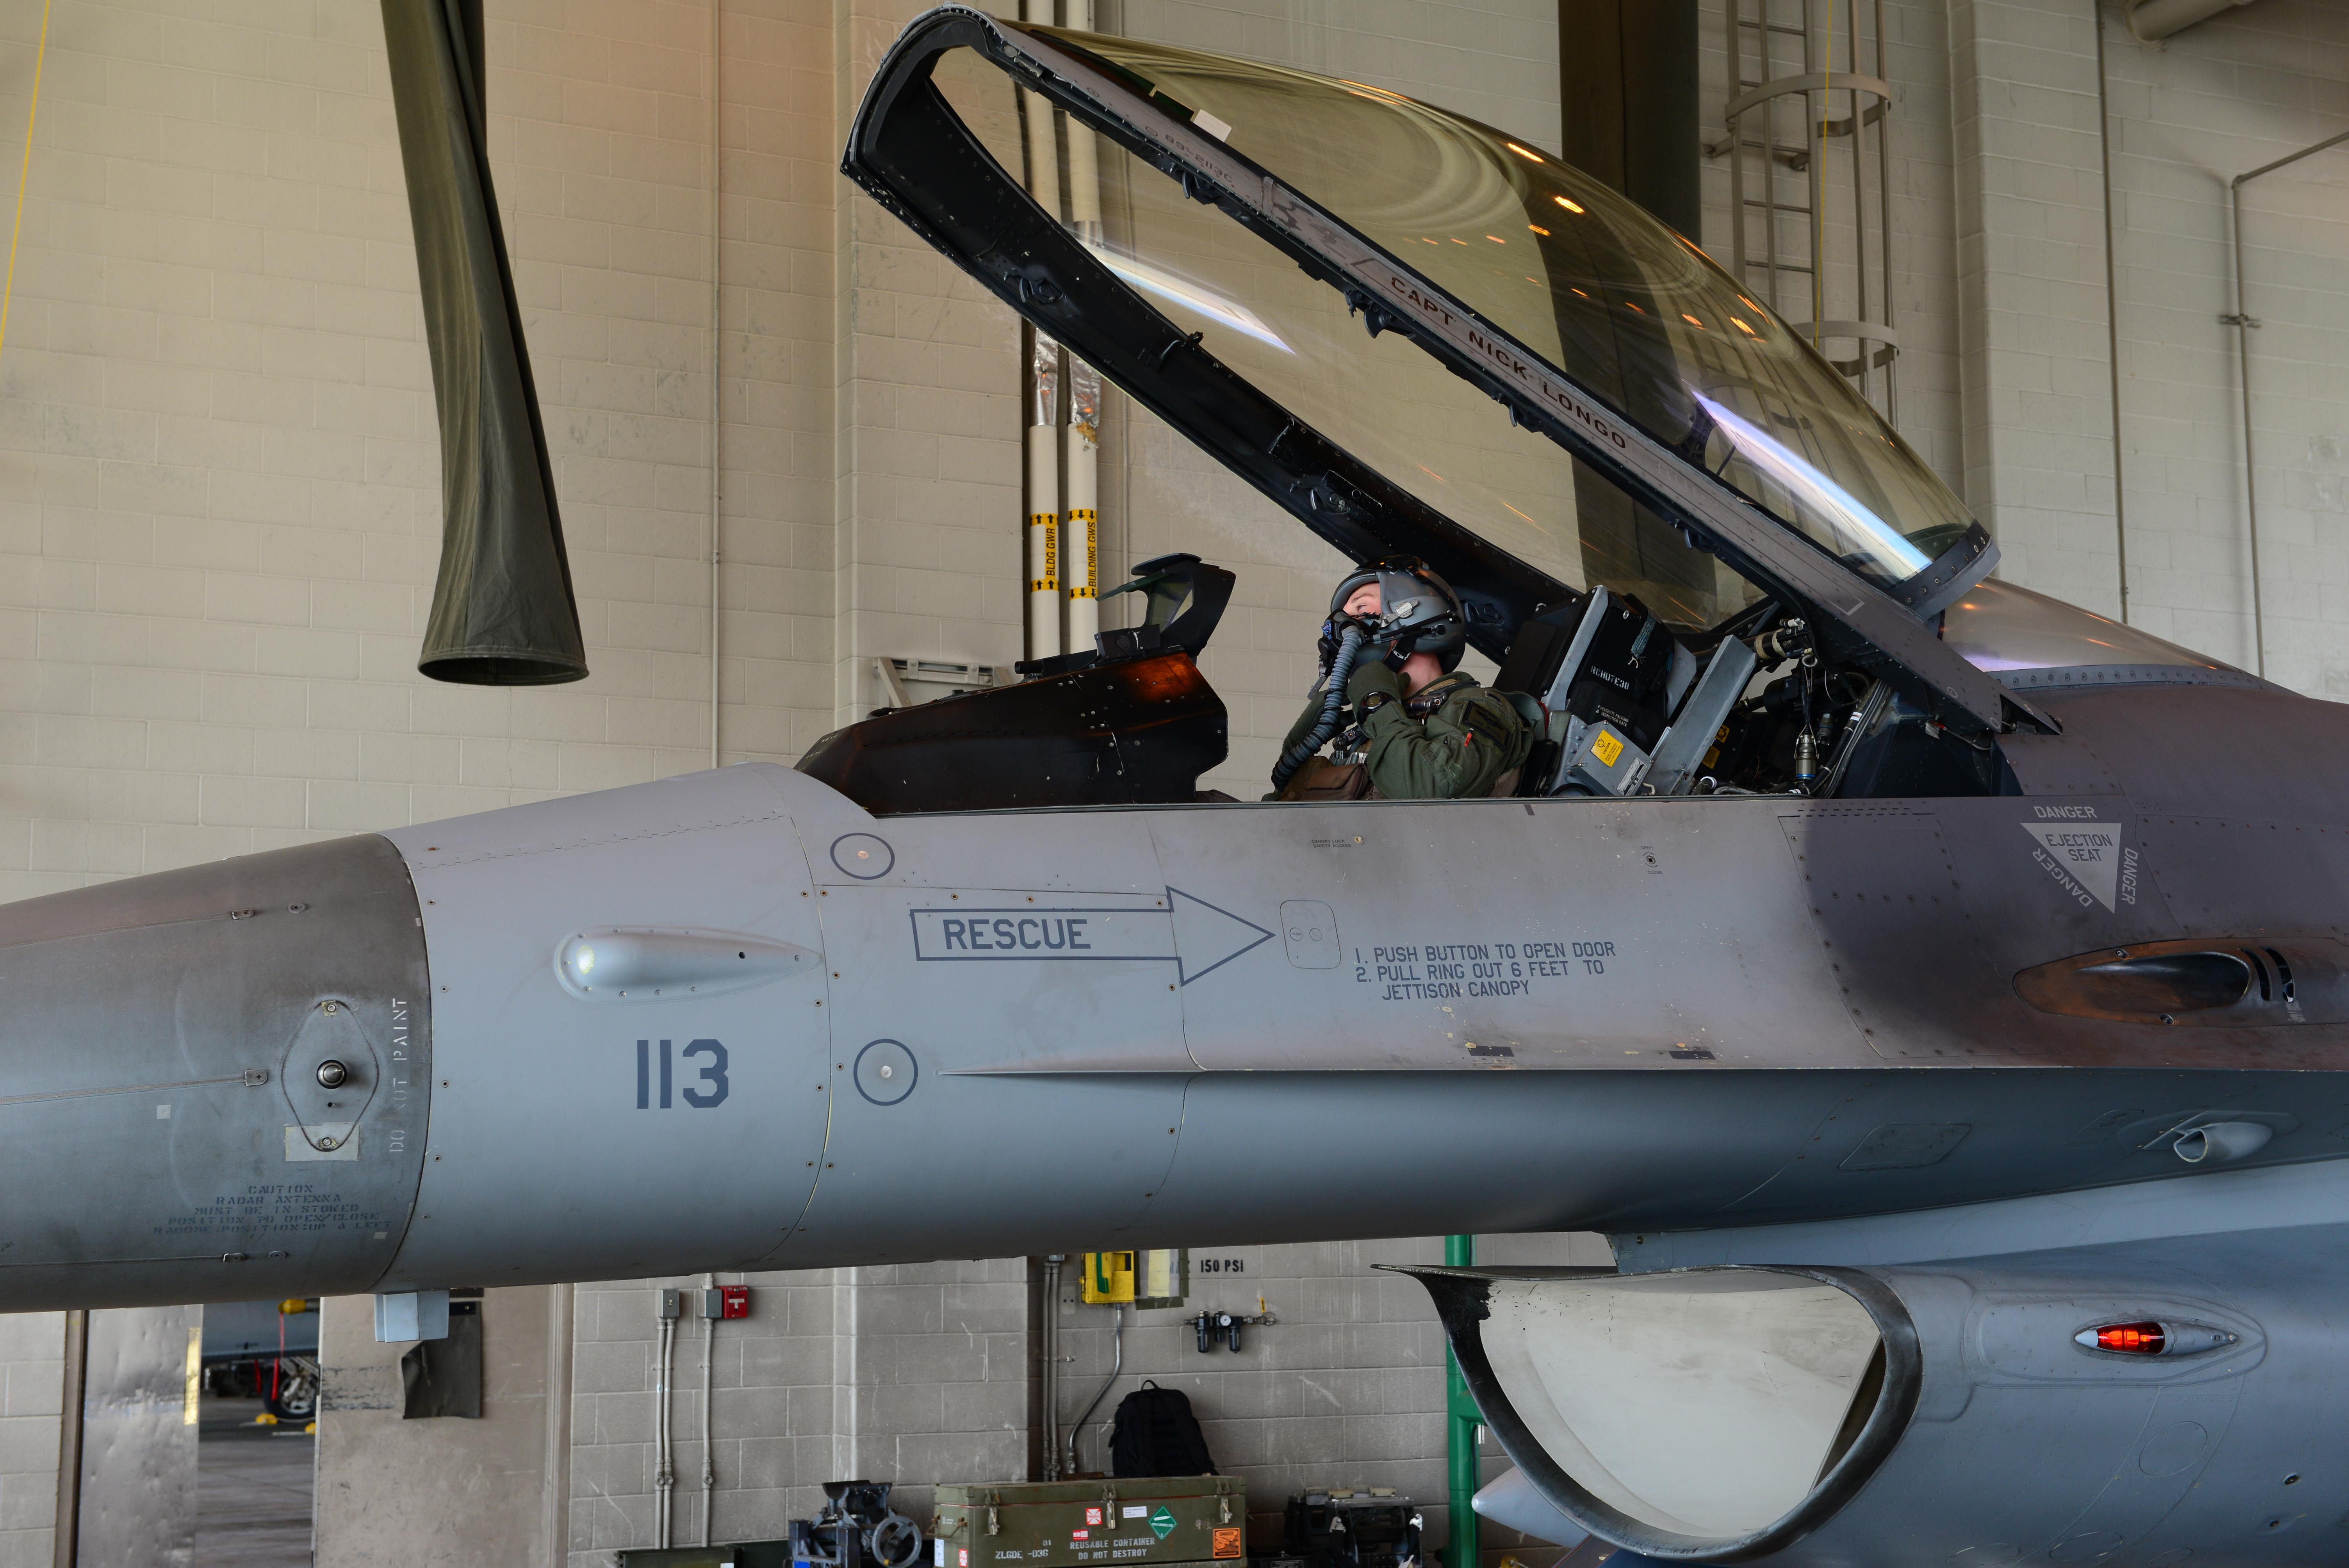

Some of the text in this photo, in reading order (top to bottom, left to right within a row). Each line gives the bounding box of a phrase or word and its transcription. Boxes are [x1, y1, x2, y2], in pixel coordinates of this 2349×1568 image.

[1392, 277, 1626, 449] CAPT NICK LONGO
[1046, 551, 1055, 576] BLDG
[1597, 705, 1615, 715] PARACHUTE
[1601, 712, 1618, 723] INSPECTION
[2034, 806, 2098, 818] DANGER
[2045, 834, 2113, 846] EJECTION
[2068, 849, 2102, 861] SEAT
[2032, 848, 2093, 907] DANGER
[2121, 847, 2138, 905] DANGER
[943, 919, 1091, 950] RESCUE
[1355, 942, 1616, 964] 1. PUSH BUTTON TO OPEN DOOR
[1356, 960, 1604, 982] 2. PULL RING OUT 6 FEET TO
[1382, 980, 1529, 1000] JETTISON CANOPY
[393, 998, 407, 1060] PAINT
[637, 1039, 729, 1109] 113
[390, 1130, 405, 1151] DO
[249, 1185, 312, 1194] CAUTION
[216, 1194, 340, 1205] RADAR ANTENNA
[195, 1206, 233, 1215] MUST
[301, 1205, 358, 1213] STOWED
[285, 1213, 380, 1222] OPEN/CLOSE
[1201, 1260, 1219, 1272] 150
[1224, 1260, 1243, 1272] PSI
[1070, 1538, 1155, 1549] REUSABLE CONTAINER
[1113, 1548, 1147, 1558] DESTROY
